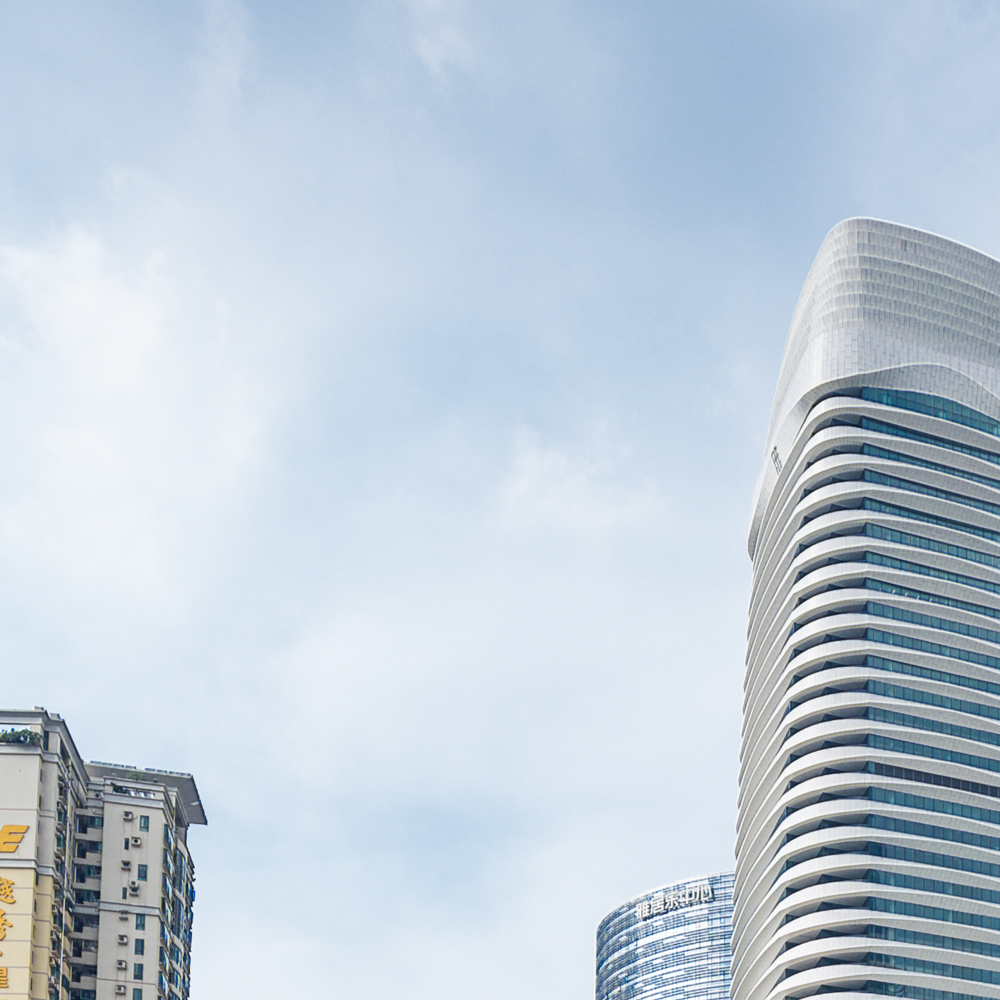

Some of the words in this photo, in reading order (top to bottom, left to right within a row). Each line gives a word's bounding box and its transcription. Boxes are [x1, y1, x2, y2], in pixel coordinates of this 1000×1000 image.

[635, 884, 714, 919] 雅居乐中心
